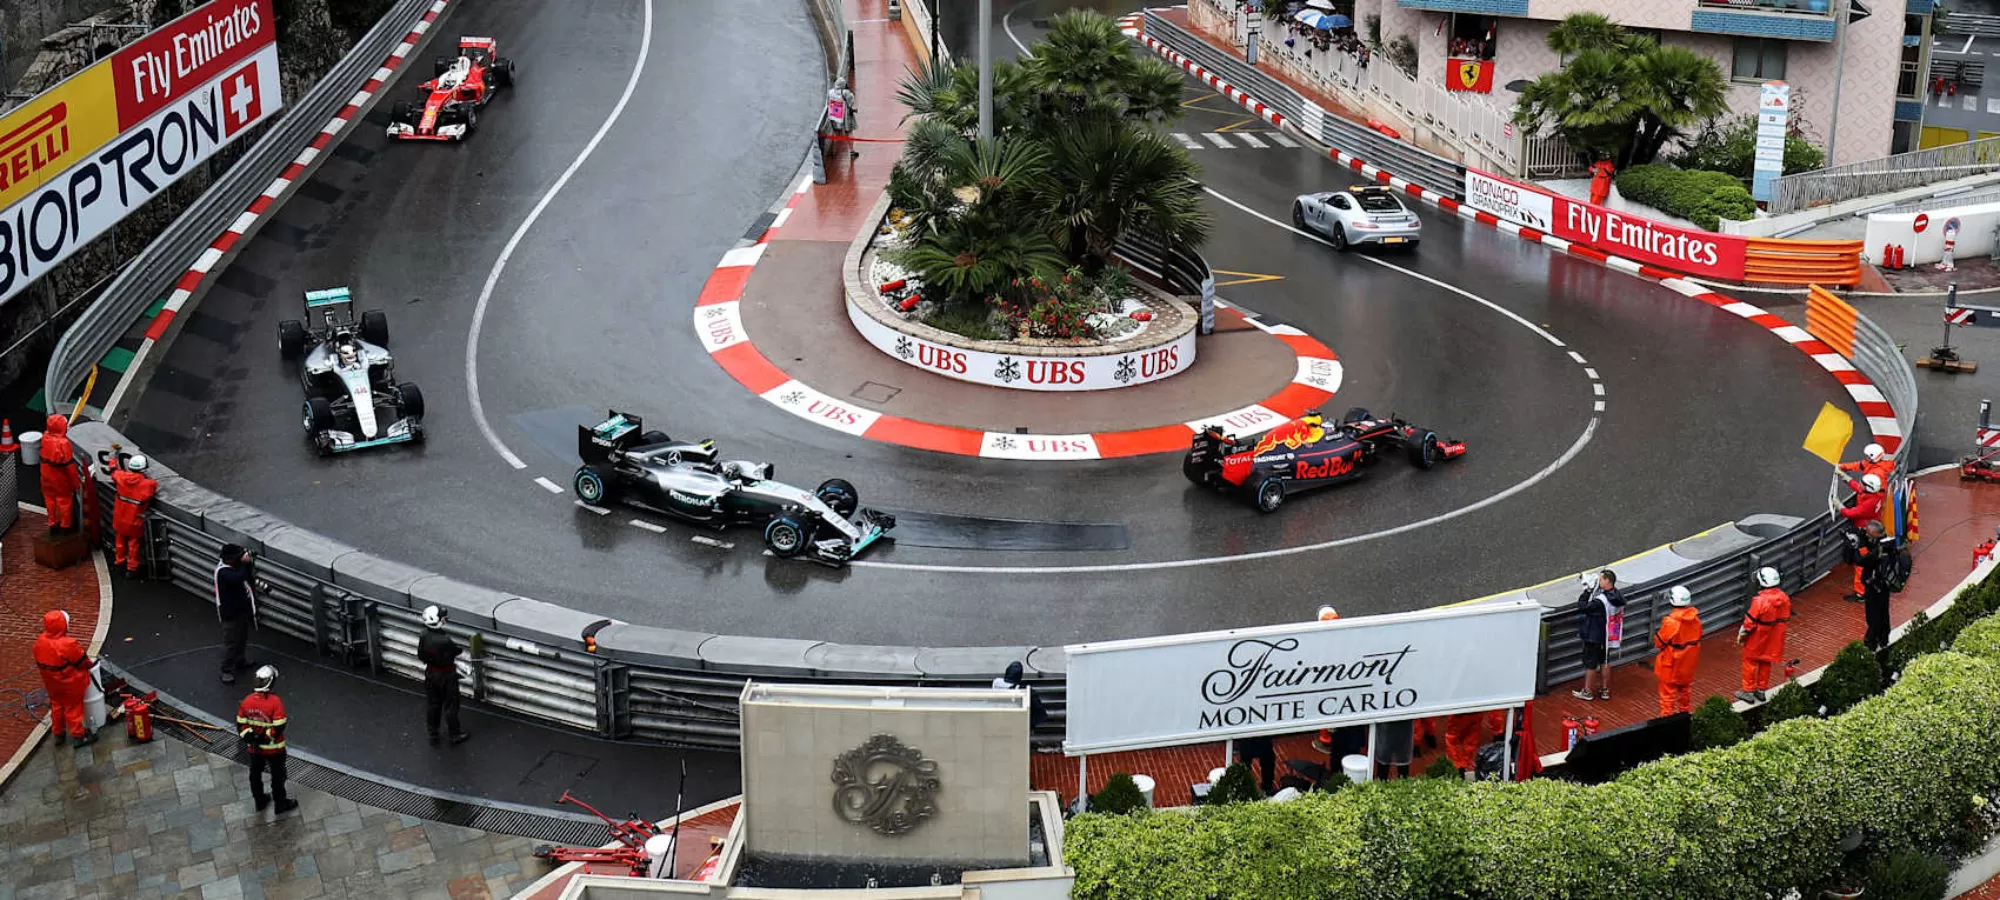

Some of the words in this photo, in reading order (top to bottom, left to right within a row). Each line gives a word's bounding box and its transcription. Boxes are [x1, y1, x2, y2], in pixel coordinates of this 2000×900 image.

[131, 50, 171, 104] Fly
[172, 2, 261, 79] Emirates
[1472, 177, 1519, 206] MONACO
[1567, 201, 1601, 243] Fly
[1605, 214, 1718, 266] Emirates
[708, 318, 735, 345] UBS
[917, 343, 968, 374] UBS
[1026, 360, 1086, 384] UBS
[1141, 344, 1179, 378] UBS
[807, 401, 862, 425] UBS
[1225, 409, 1274, 430] UBS
[1027, 439, 1088, 453] UBS
[1224, 456, 1251, 466] TOTAL
[1202, 638, 1418, 705] Fairmont
[1198, 700, 1305, 729] MONTE
[1317, 688, 1418, 716] CARLO
